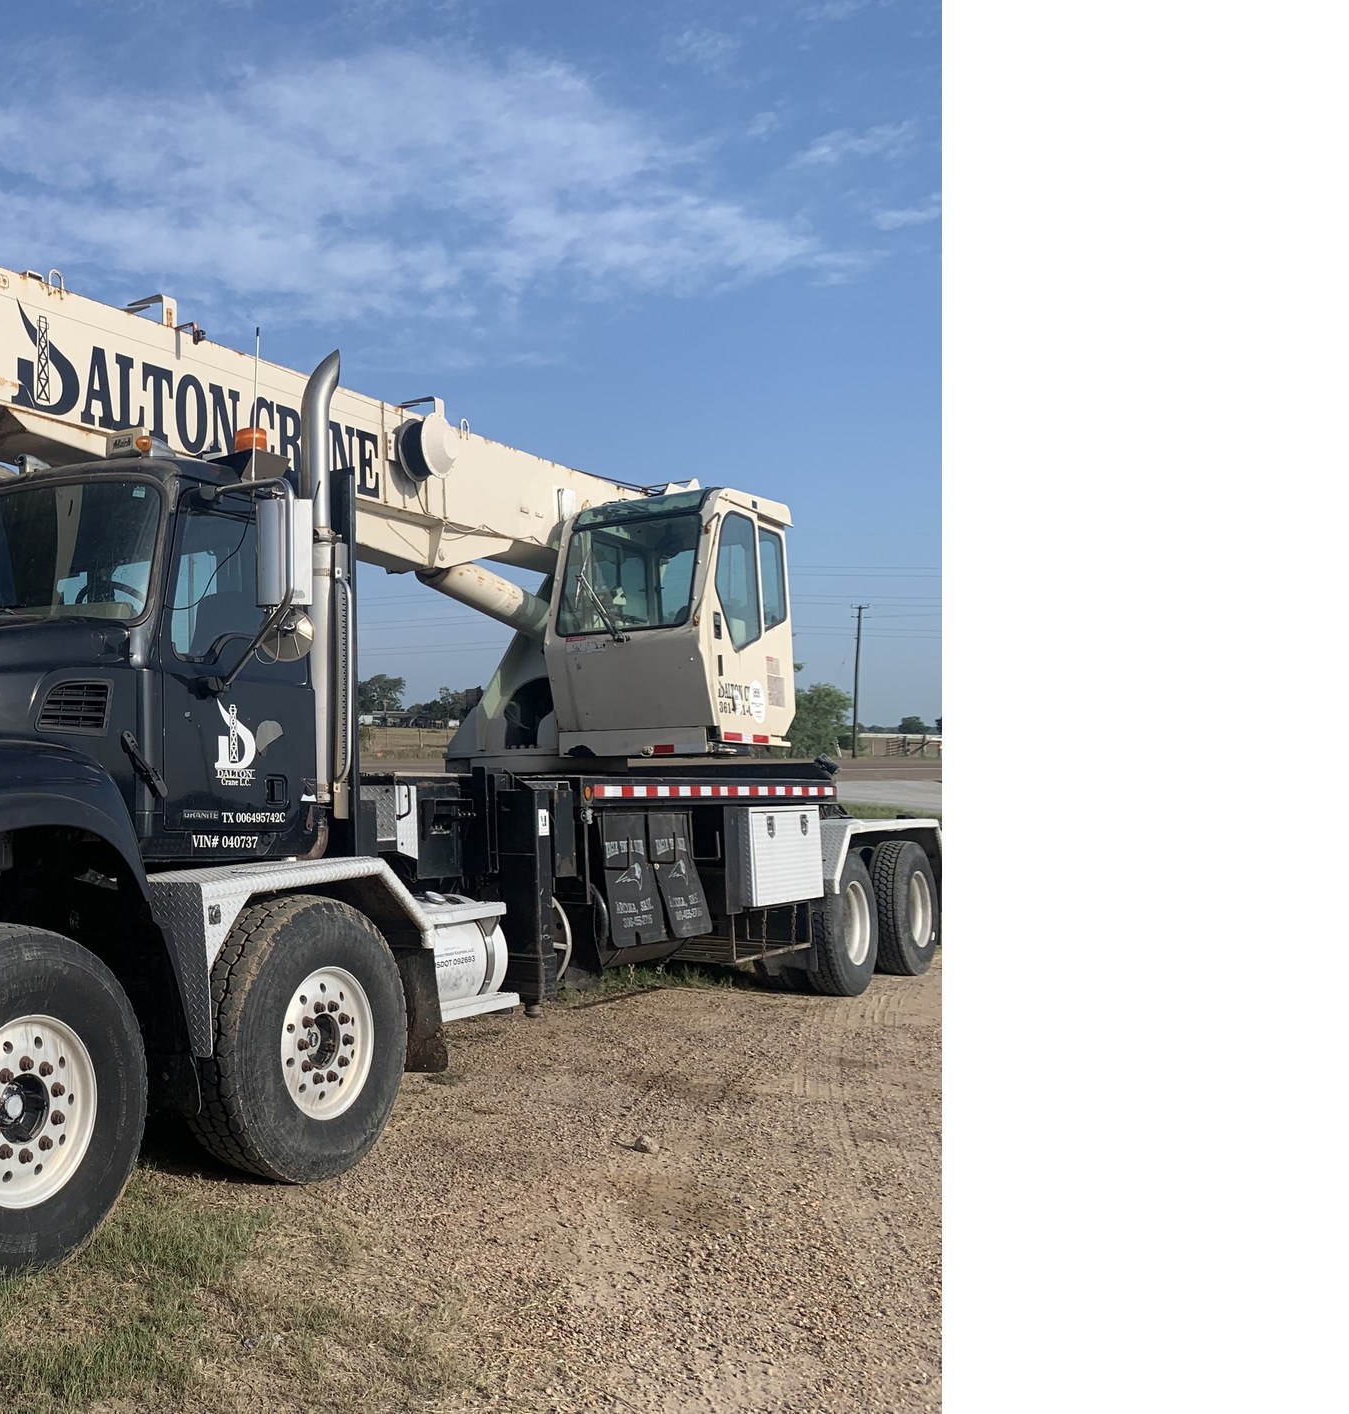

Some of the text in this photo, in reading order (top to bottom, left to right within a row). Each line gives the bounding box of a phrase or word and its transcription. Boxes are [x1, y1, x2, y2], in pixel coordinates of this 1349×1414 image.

[11, 298, 381, 498] DALTON CRNE
[216, 769, 254, 779] DALTON
[221, 778, 252, 787] Crane L.C.
[221, 812, 234, 824] TX
[236, 812, 286, 824] 006495742C
[192, 834, 259, 849] VIN# 040737
